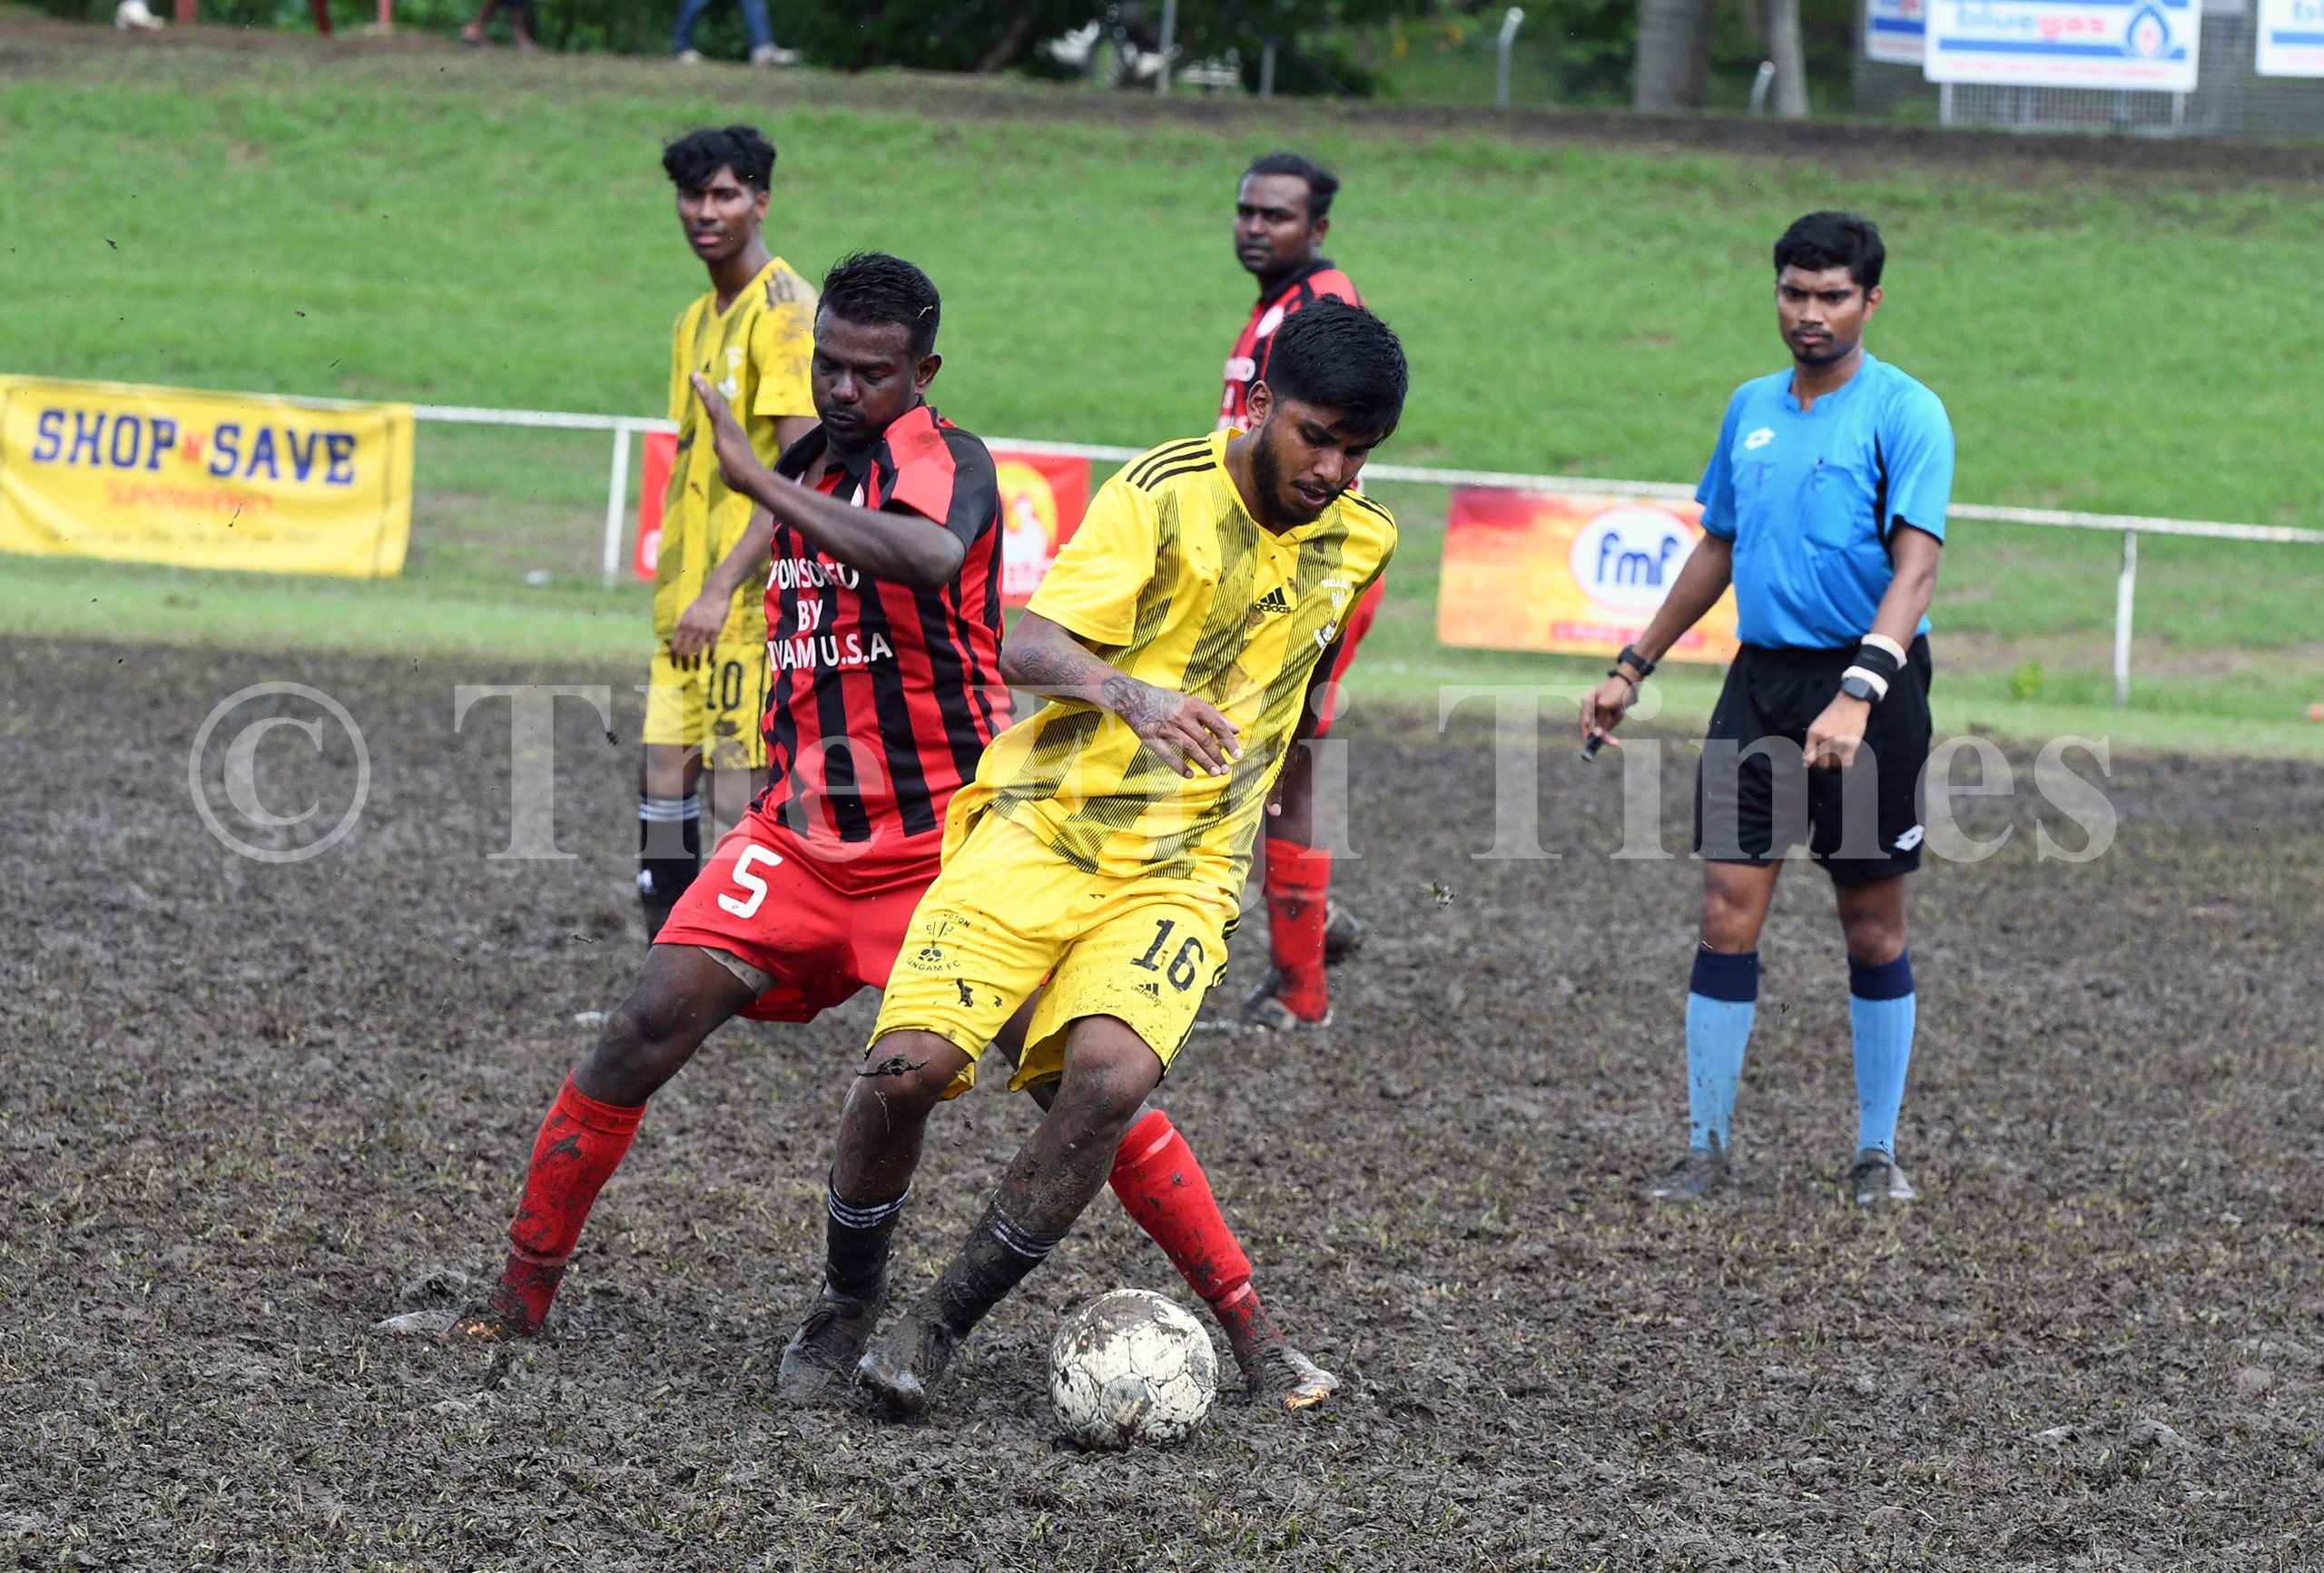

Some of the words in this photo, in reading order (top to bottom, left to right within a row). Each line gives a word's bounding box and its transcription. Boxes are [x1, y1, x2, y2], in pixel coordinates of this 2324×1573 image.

[32, 409, 177, 470] SHOP
[208, 424, 357, 486] SAVE
[1598, 532, 1678, 586] fmf
[797, 599, 823, 632] BY
[1255, 604, 1291, 614] adidas
[821, 632, 893, 667] U.S.A
[717, 843, 784, 919] 5
[1130, 919, 1205, 992] 16
